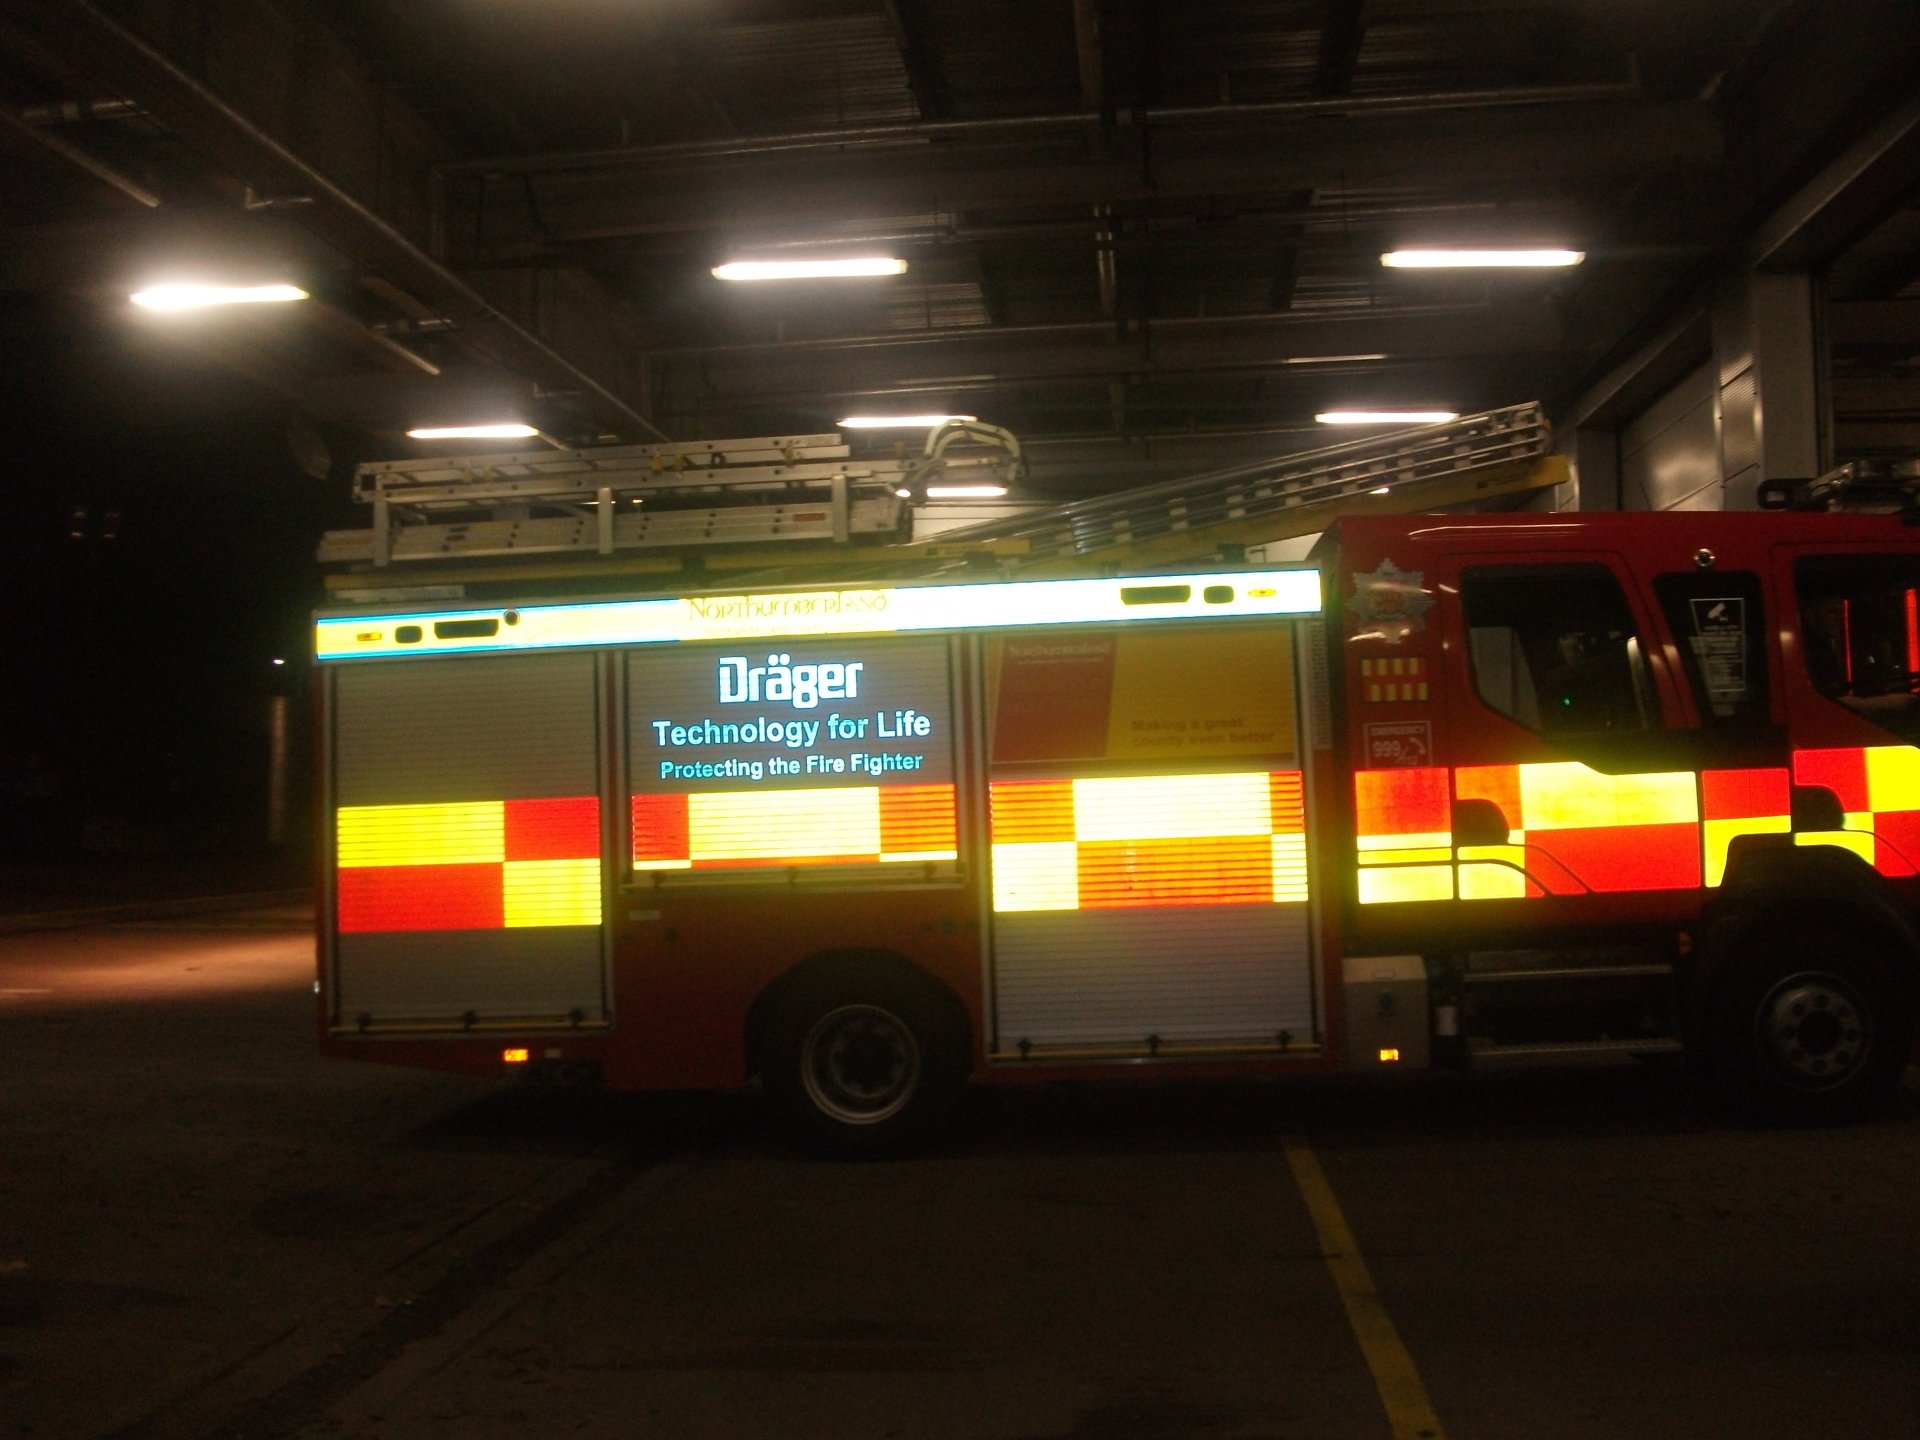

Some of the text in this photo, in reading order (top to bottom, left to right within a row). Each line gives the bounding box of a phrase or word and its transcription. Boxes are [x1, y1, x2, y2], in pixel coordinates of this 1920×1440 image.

[719, 653, 864, 709] Dräger
[652, 709, 932, 748] Technology for Life
[660, 752, 924, 780] Protecting the Fire Fighter
